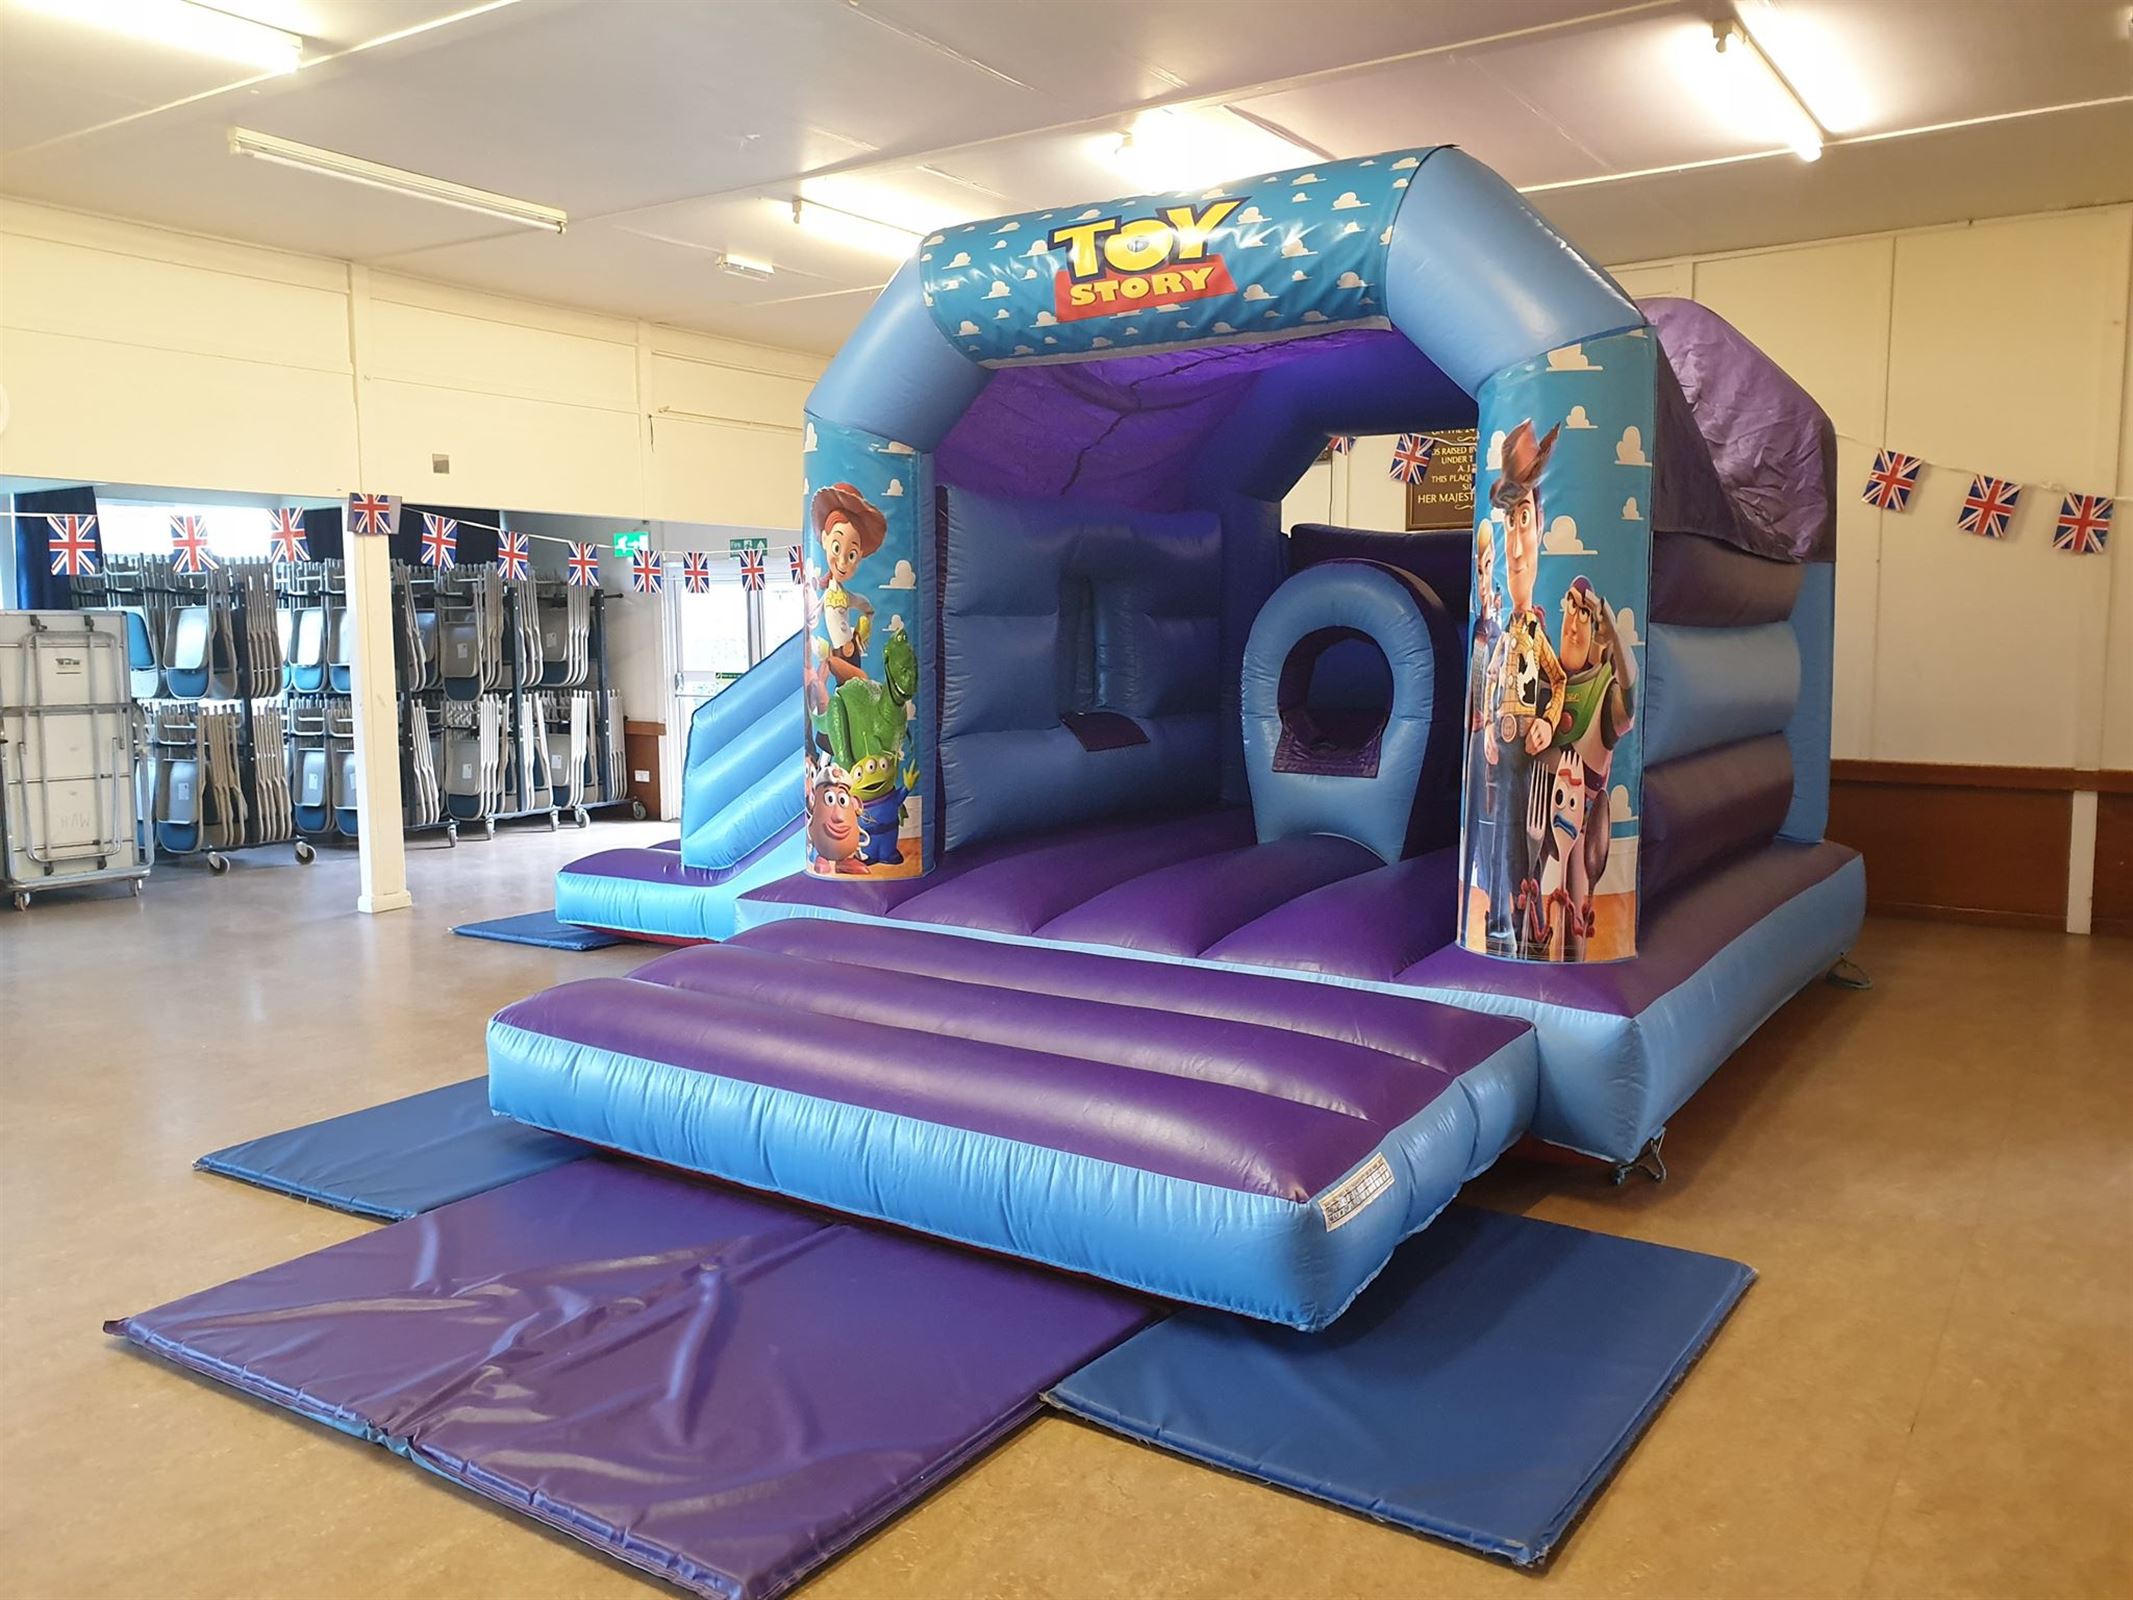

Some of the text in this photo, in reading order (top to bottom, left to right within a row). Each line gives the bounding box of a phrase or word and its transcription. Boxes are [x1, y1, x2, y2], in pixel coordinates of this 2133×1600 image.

[1050, 198, 1248, 281] TOY
[1070, 266, 1216, 306] STORY
[1441, 446, 1467, 455] RAISED
[1441, 456, 1467, 464] UNDER
[1432, 475, 1447, 483] THIS
[1417, 492, 1473, 503] HER MAJEST
